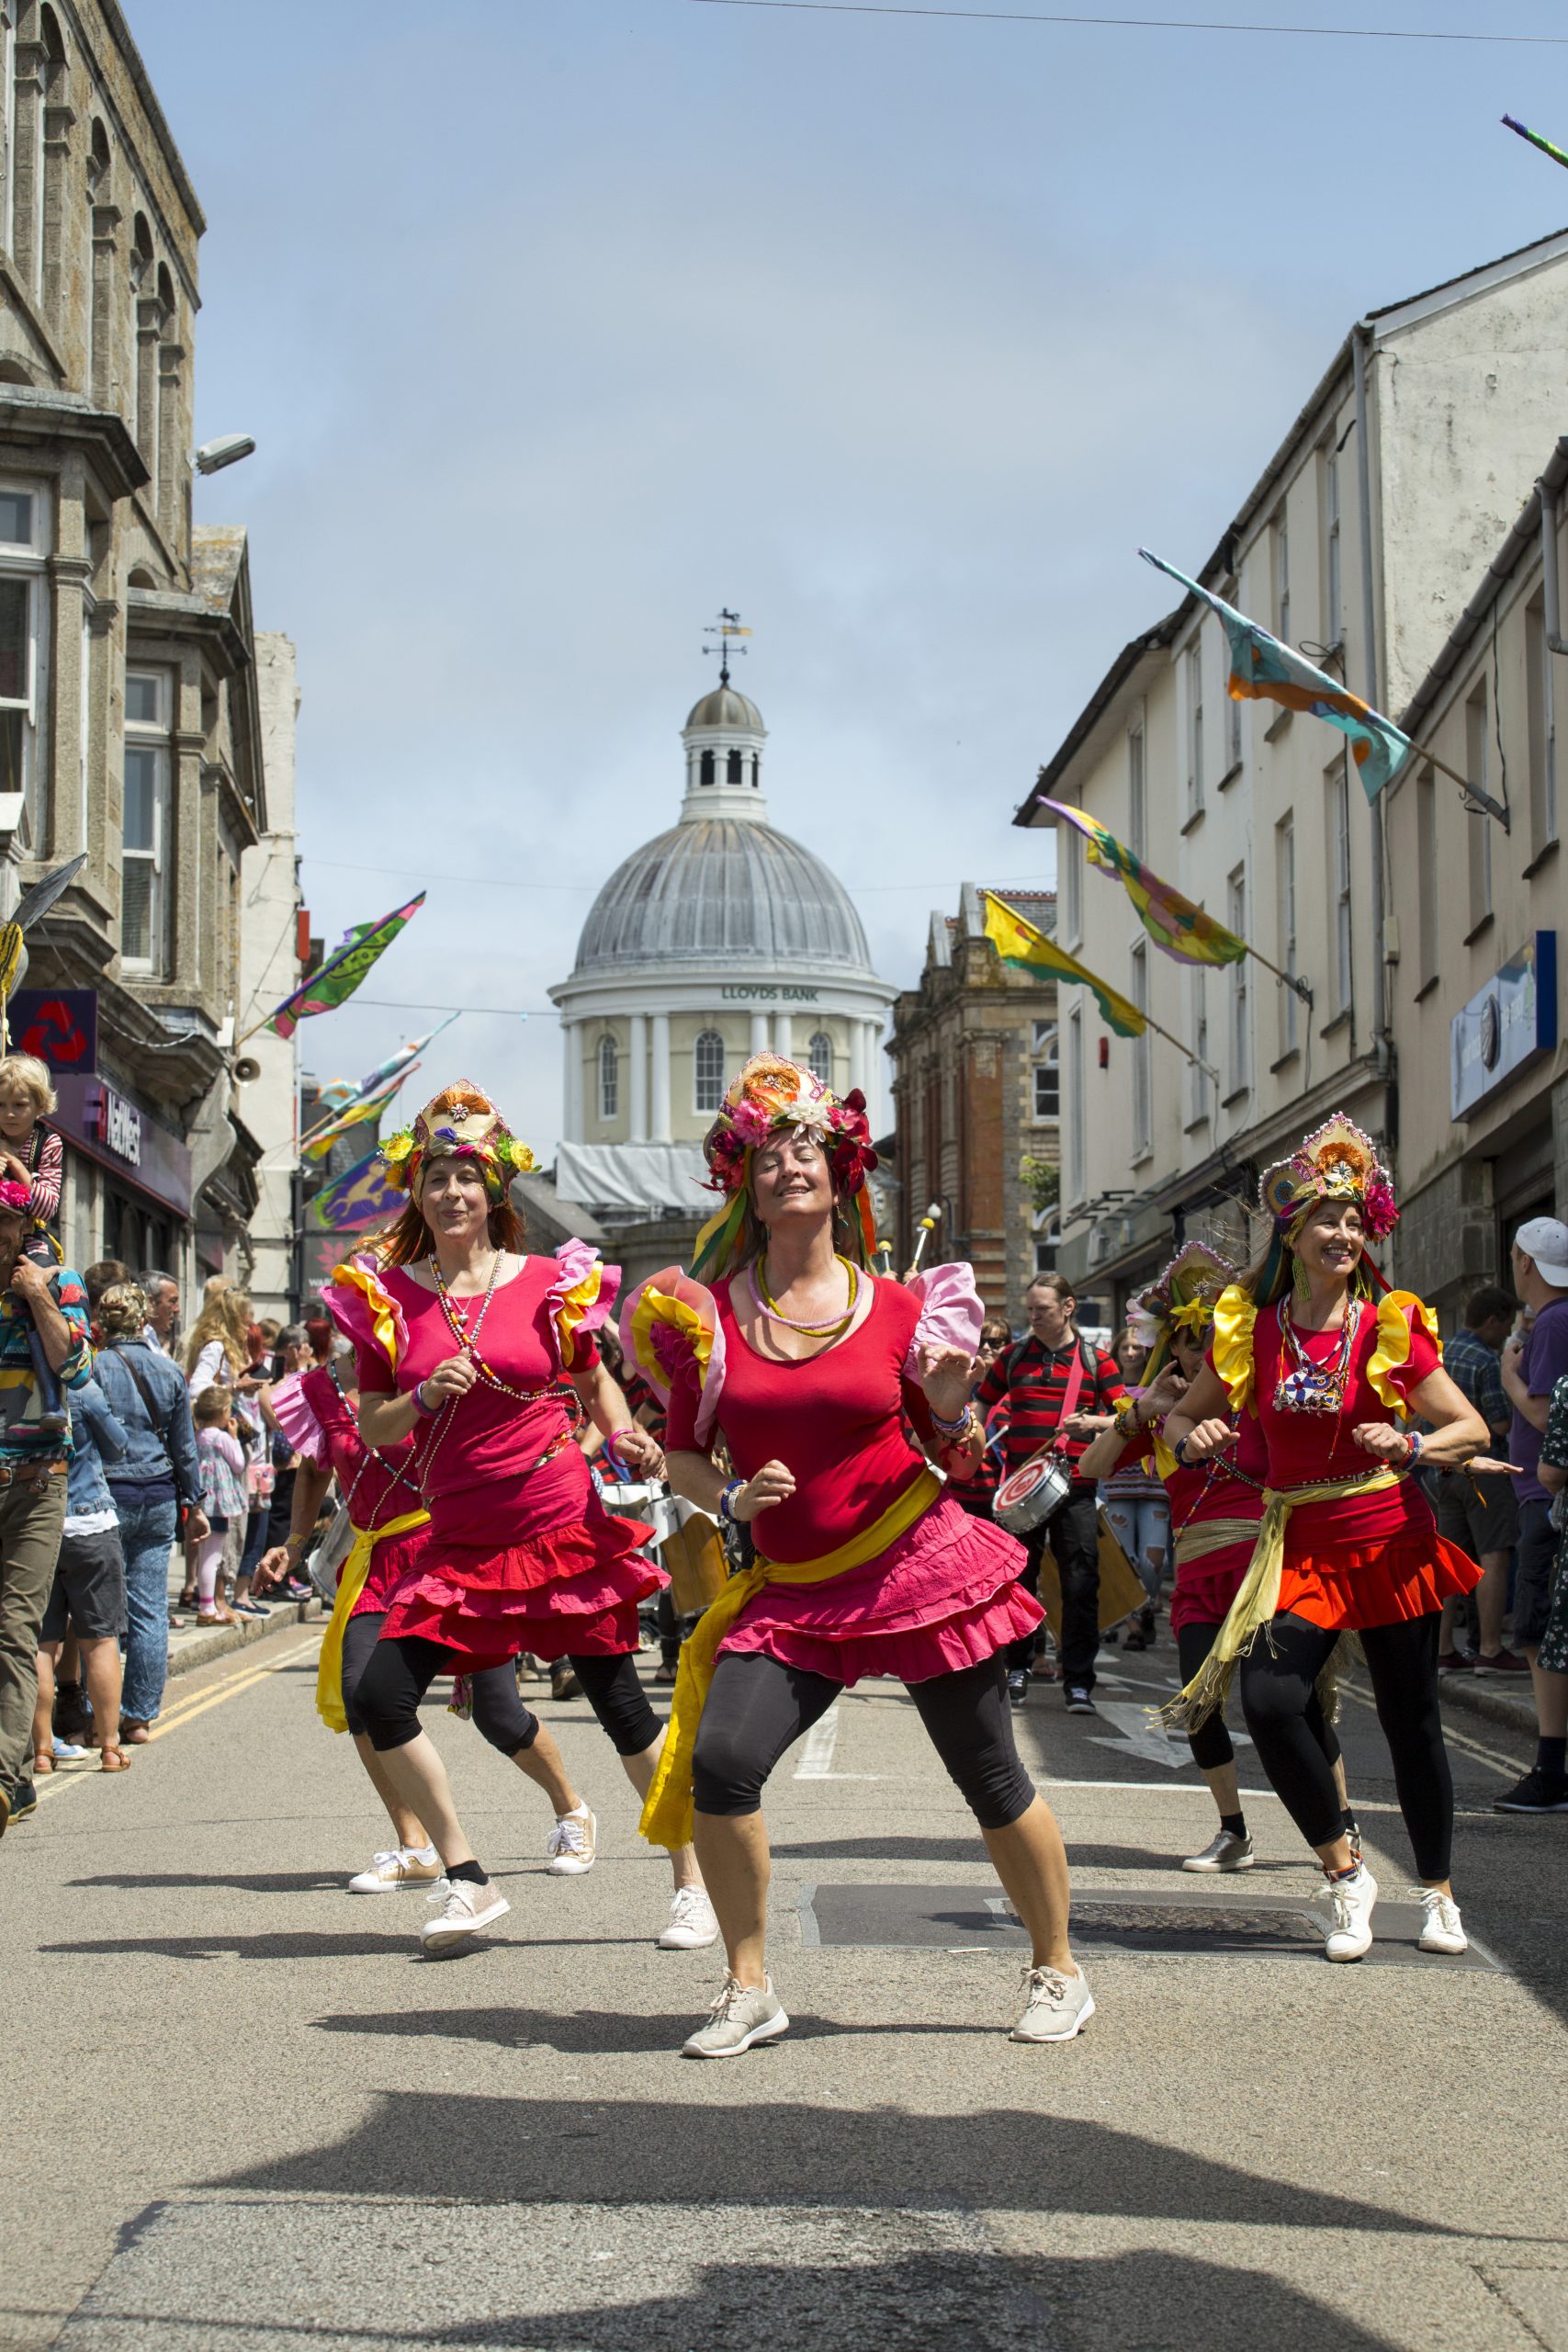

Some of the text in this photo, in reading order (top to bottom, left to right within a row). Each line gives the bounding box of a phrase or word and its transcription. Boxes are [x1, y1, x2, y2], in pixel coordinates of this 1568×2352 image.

[721, 986, 818, 1002] LLOYDS BANK
[107, 1091, 141, 1167] NatWest
